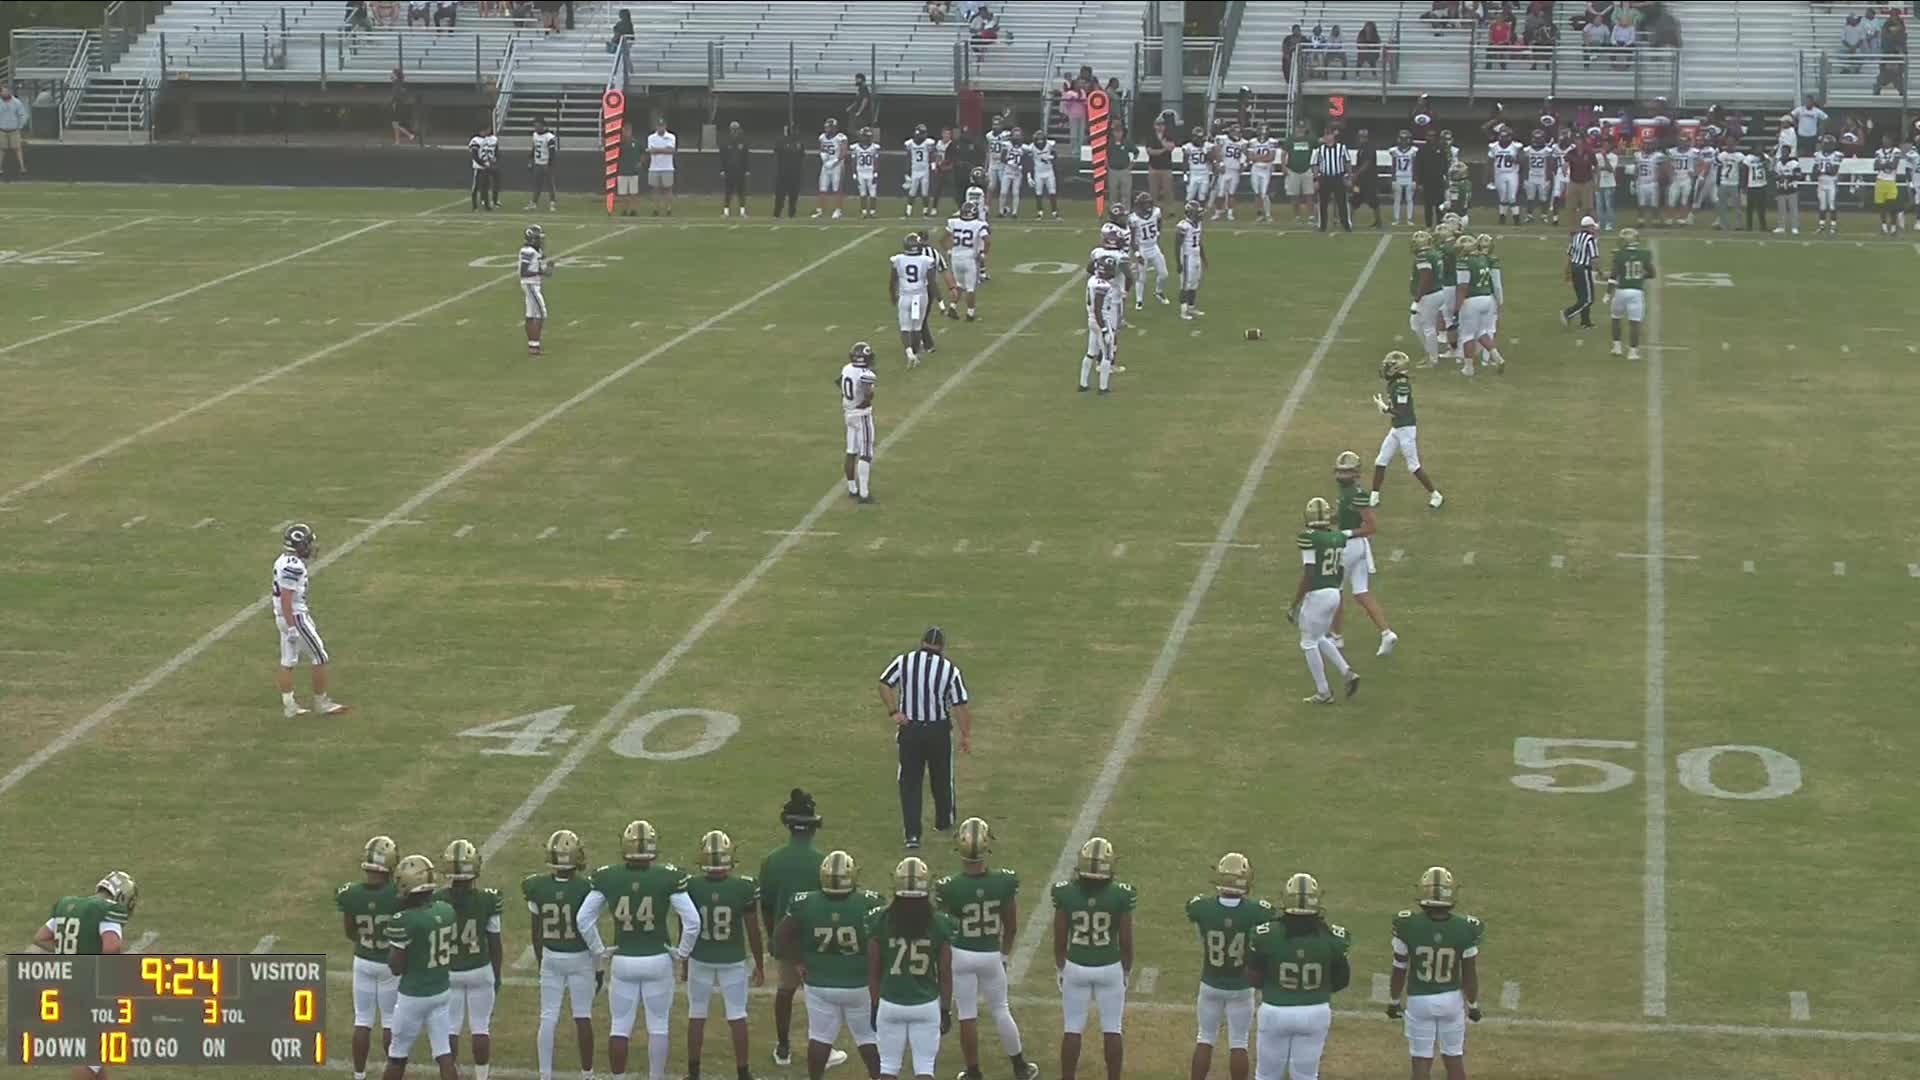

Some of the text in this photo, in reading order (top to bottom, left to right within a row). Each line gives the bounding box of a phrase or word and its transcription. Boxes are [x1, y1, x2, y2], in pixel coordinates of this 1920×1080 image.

[916, 151, 924, 162] 3
[1530, 157, 1545, 168] 22
[953, 228, 974, 248] 52
[1141, 225, 1157, 241] 15
[905, 265, 919, 283] 9
[1624, 261, 1642, 280] 10
[541, 903, 577, 940] 21
[615, 896, 655, 932] 44
[700, 906, 732, 941] 18
[961, 901, 1004, 937] 25
[1071, 911, 1111, 946] 28
[53, 917, 80, 954] 58
[426, 925, 451, 969] 15
[814, 926, 860, 956] 79
[1207, 930, 1247, 968] 84
[888, 939, 931, 976] 75
[1415, 946, 1456, 984] 30
